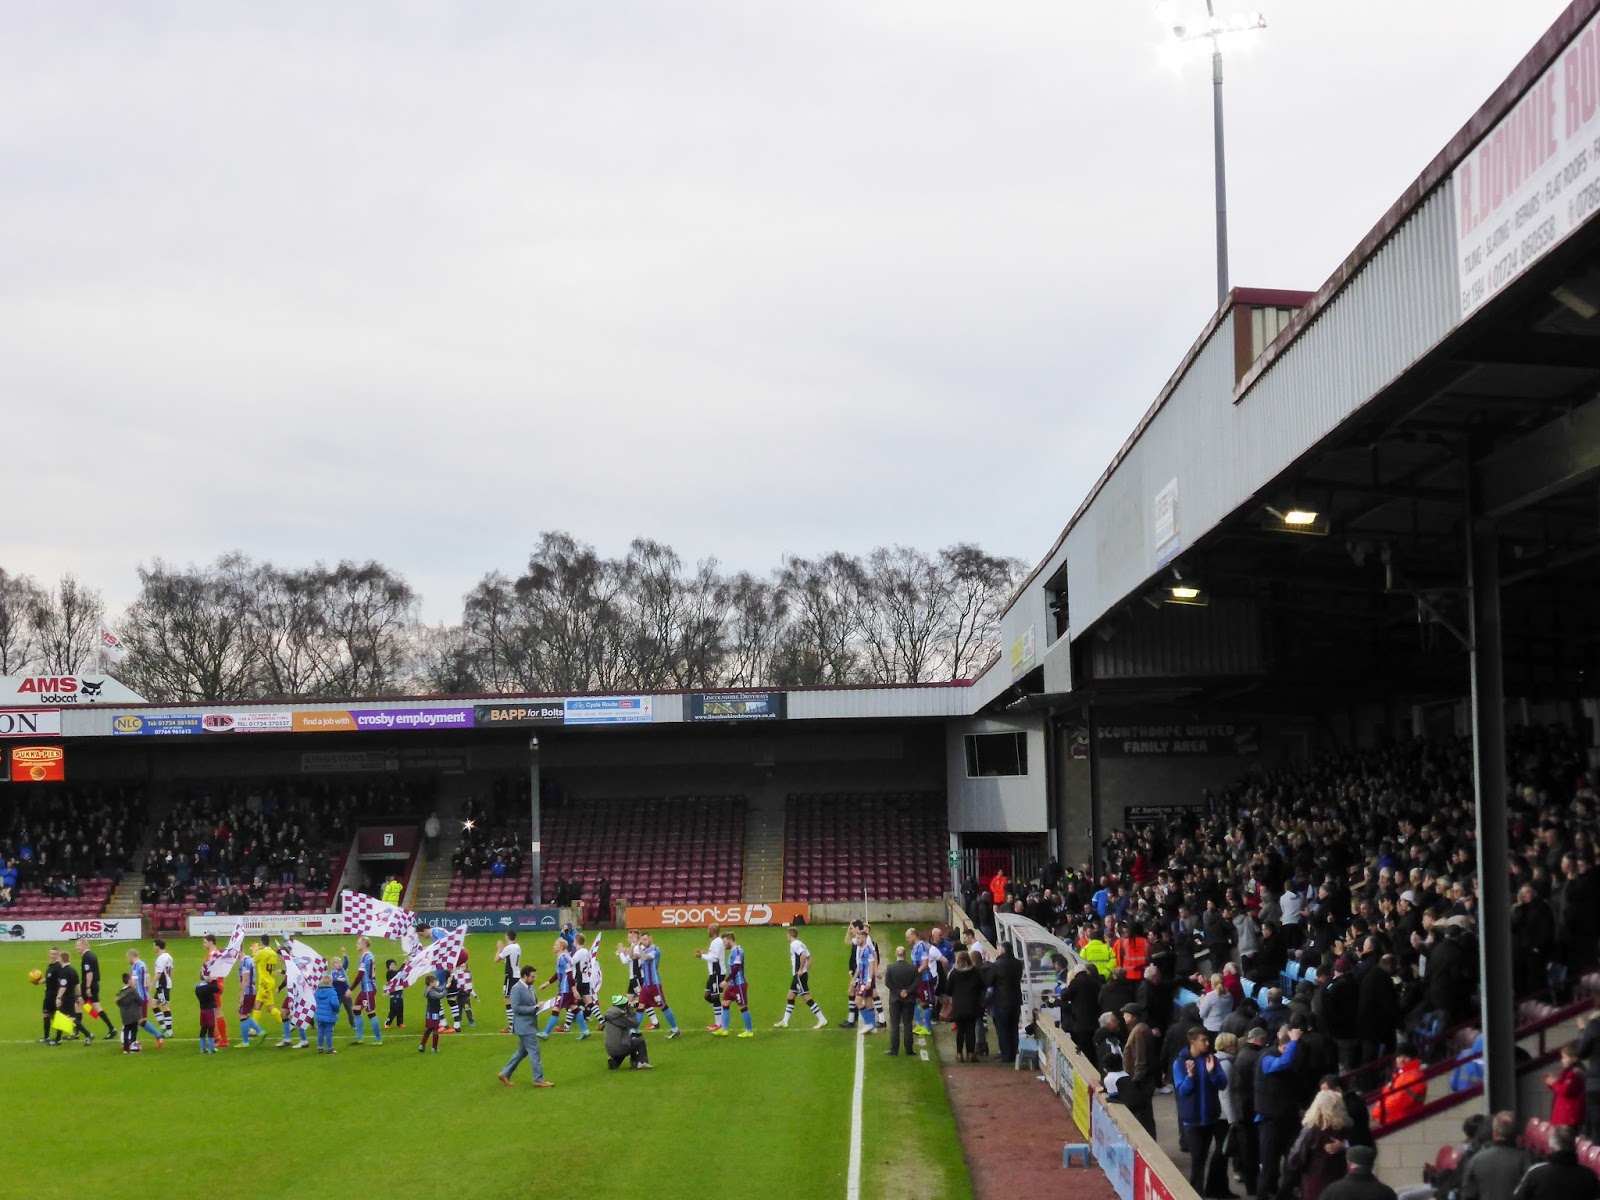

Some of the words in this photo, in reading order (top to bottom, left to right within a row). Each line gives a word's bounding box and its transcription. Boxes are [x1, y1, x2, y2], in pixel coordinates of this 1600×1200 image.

[1546, 171, 1561, 203] FLAT
[1564, 148, 1588, 190] ROOFS
[1493, 247, 1518, 289] 01724
[17, 677, 78, 693] AMS
[41, 693, 78, 703] bobcat
[358, 713, 394, 727] crosby
[396, 711, 466, 727] employment
[490, 709, 526, 721] BAPP
[527, 709, 539, 717] for
[541, 708, 564, 717] Bolts
[117, 719, 140, 729] NLC
[303, 717, 317, 725] find
[323, 717, 334, 727] job
[335, 717, 350, 725] with
[1096, 725, 1183, 738] SCUNTHORPE
[1185, 724, 1235, 737] UNITED
[1123, 741, 1170, 753] FAMILY
[1172, 740, 1208, 752] AREA
[386, 836, 391, 844] 7
[429, 917, 439, 928] of
[441, 917, 458, 927] the
[461, 916, 494, 927] match.
[661, 905, 741, 926] sports
[61, 921, 102, 932] AMS
